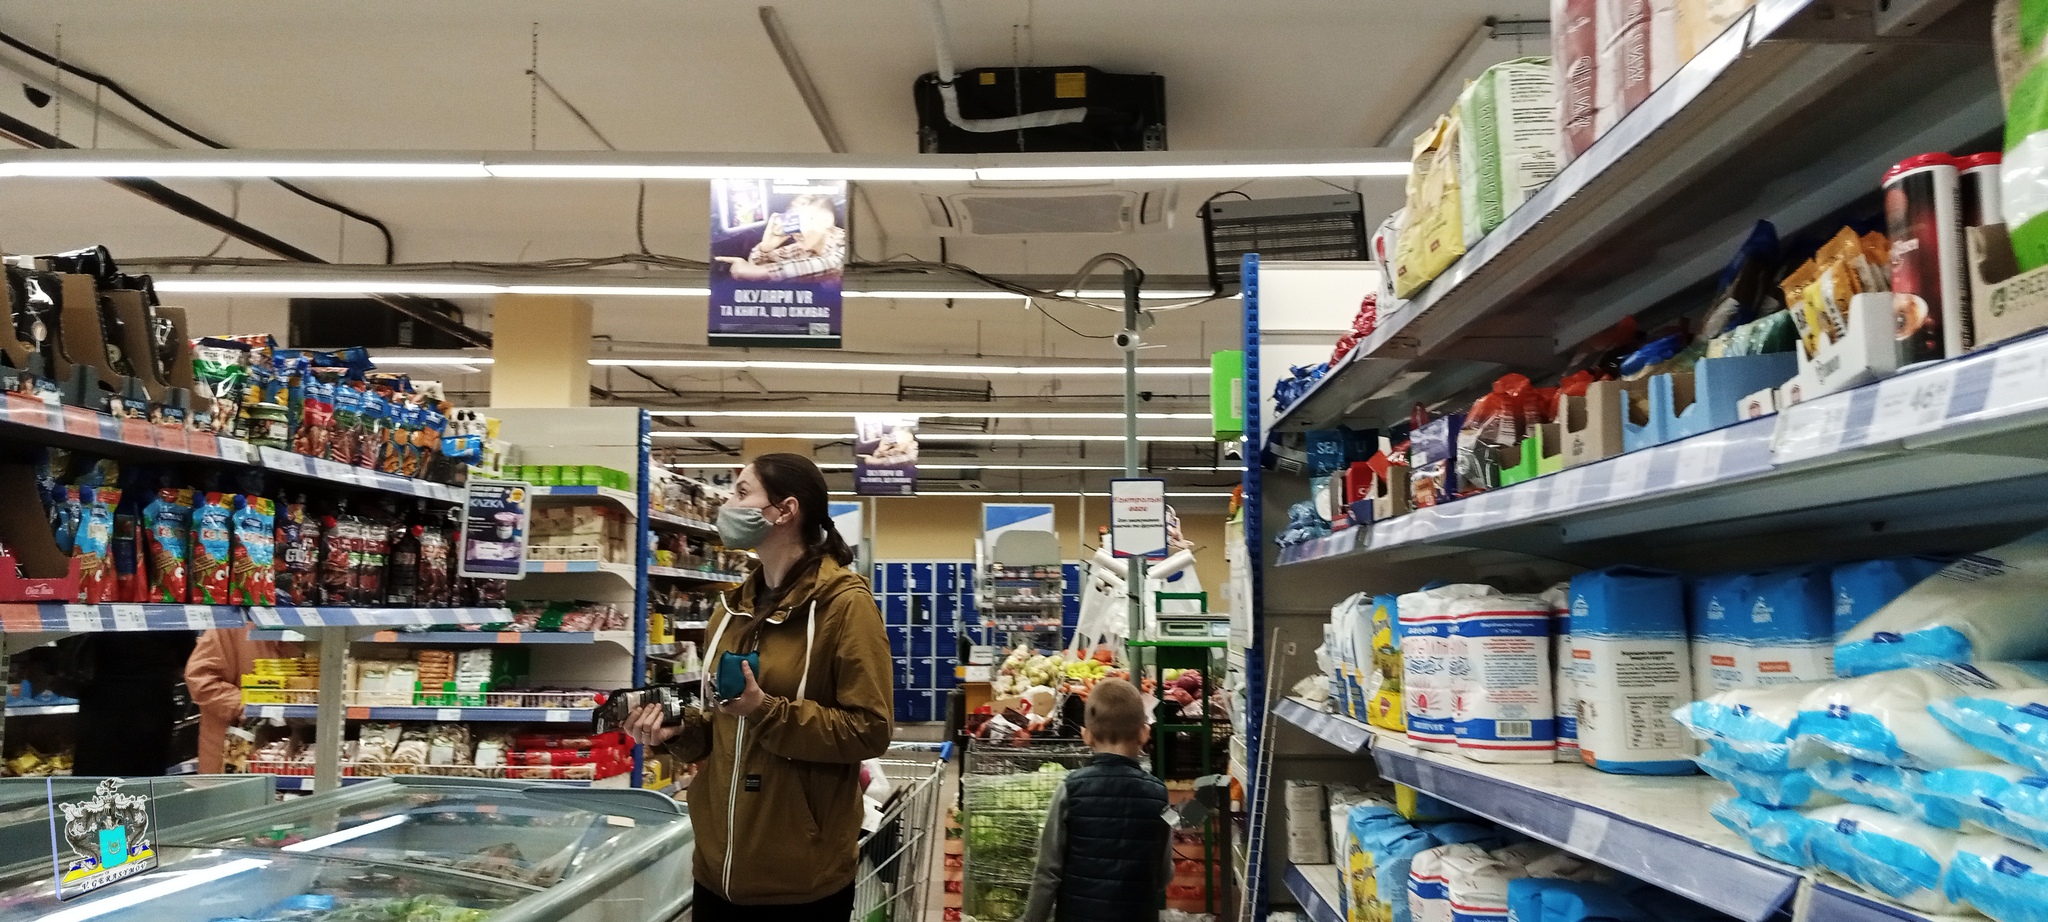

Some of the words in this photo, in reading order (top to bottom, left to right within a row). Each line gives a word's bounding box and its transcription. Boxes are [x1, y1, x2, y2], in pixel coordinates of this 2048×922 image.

[734, 289, 794, 304] ОКУЛЯРИ
[796, 290, 813, 304] VR
[720, 305, 733, 317] ТА
[771, 306, 788, 318] ЩО
[469, 499, 505, 509] KAZKA
